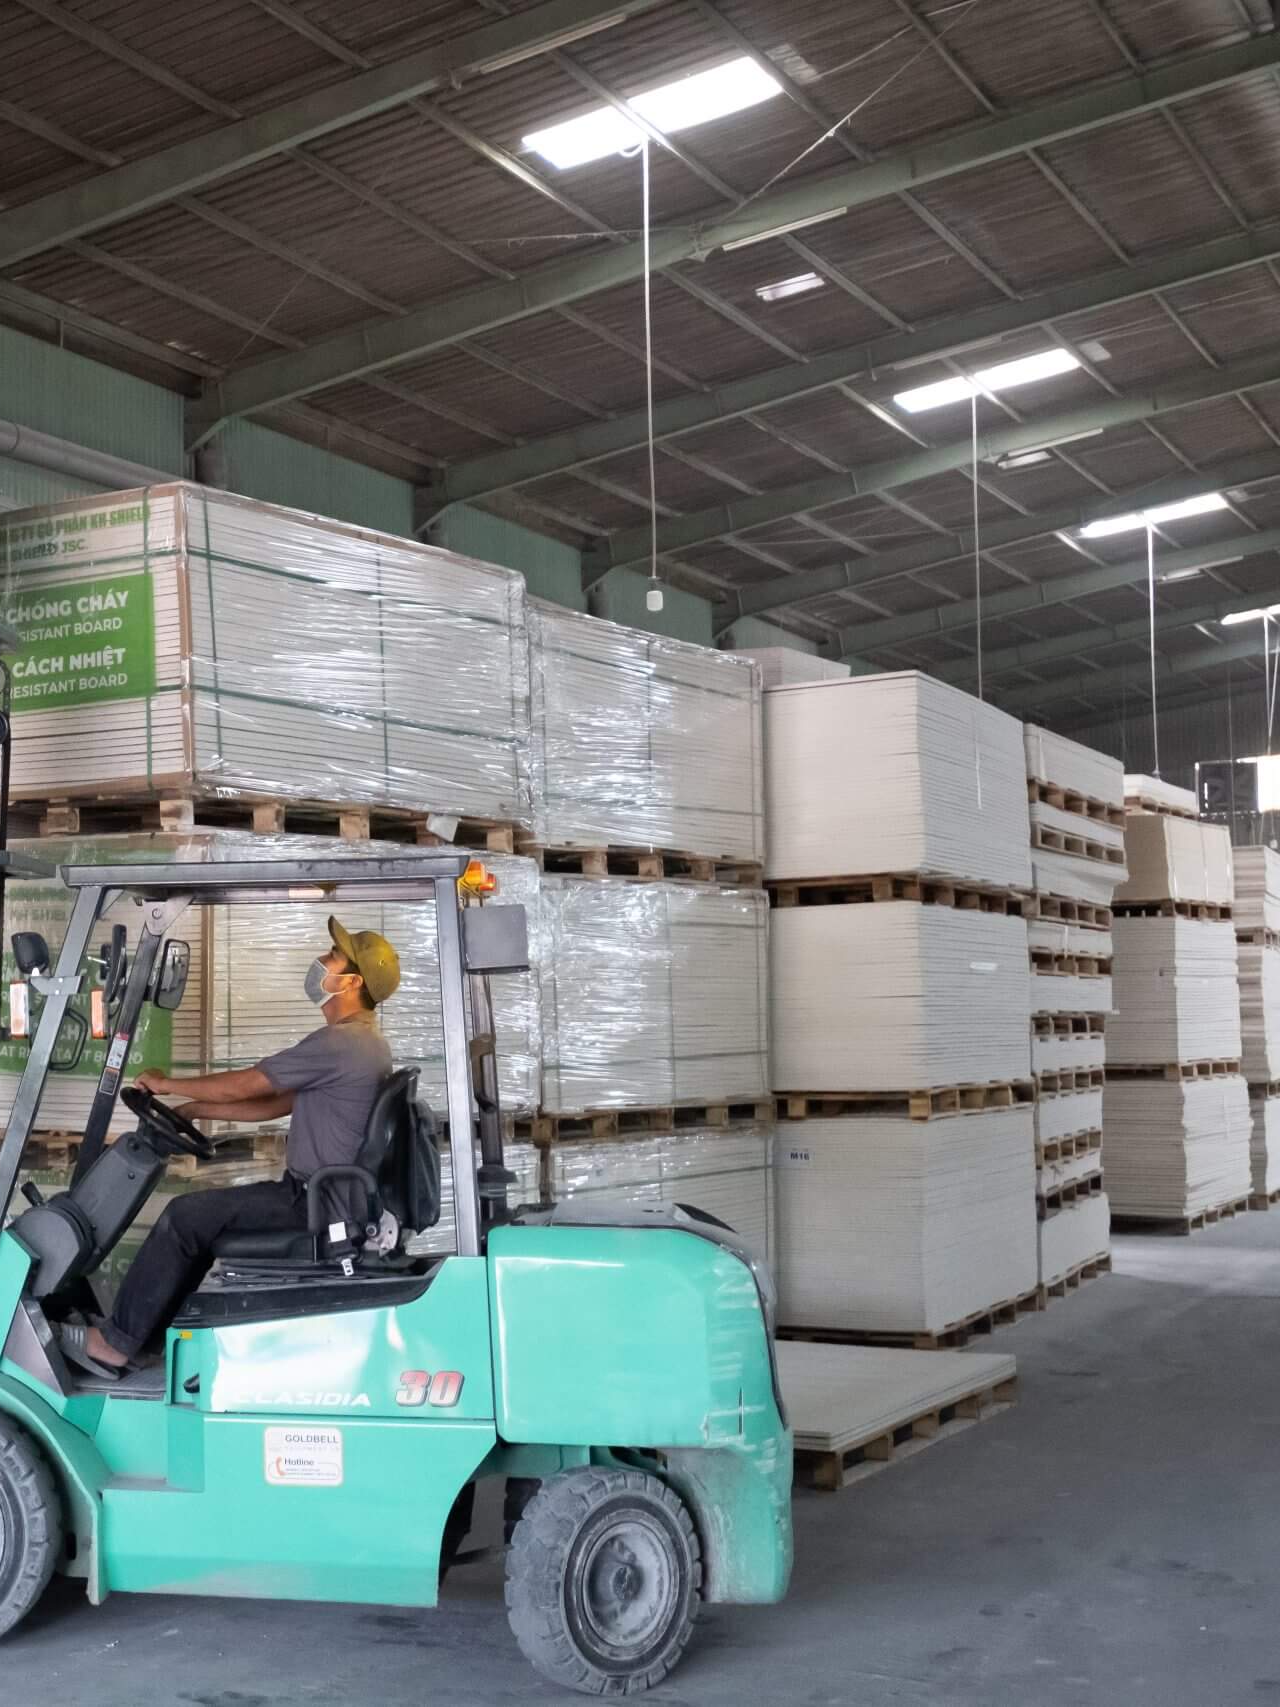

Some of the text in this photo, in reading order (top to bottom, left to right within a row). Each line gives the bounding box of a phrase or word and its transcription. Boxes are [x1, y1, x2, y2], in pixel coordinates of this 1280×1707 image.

[77, 588, 129, 613] CHÁY
[19, 617, 122, 641] SISTANT BOARD
[12, 645, 126, 678] CÁCH NHIỆT
[10, 672, 128, 699] ESISTANT BOARD
[395, 1371, 465, 1407] 30
[285, 1434, 339, 1444] GOLDBELL
[284, 1457, 315, 1466] Hotline
